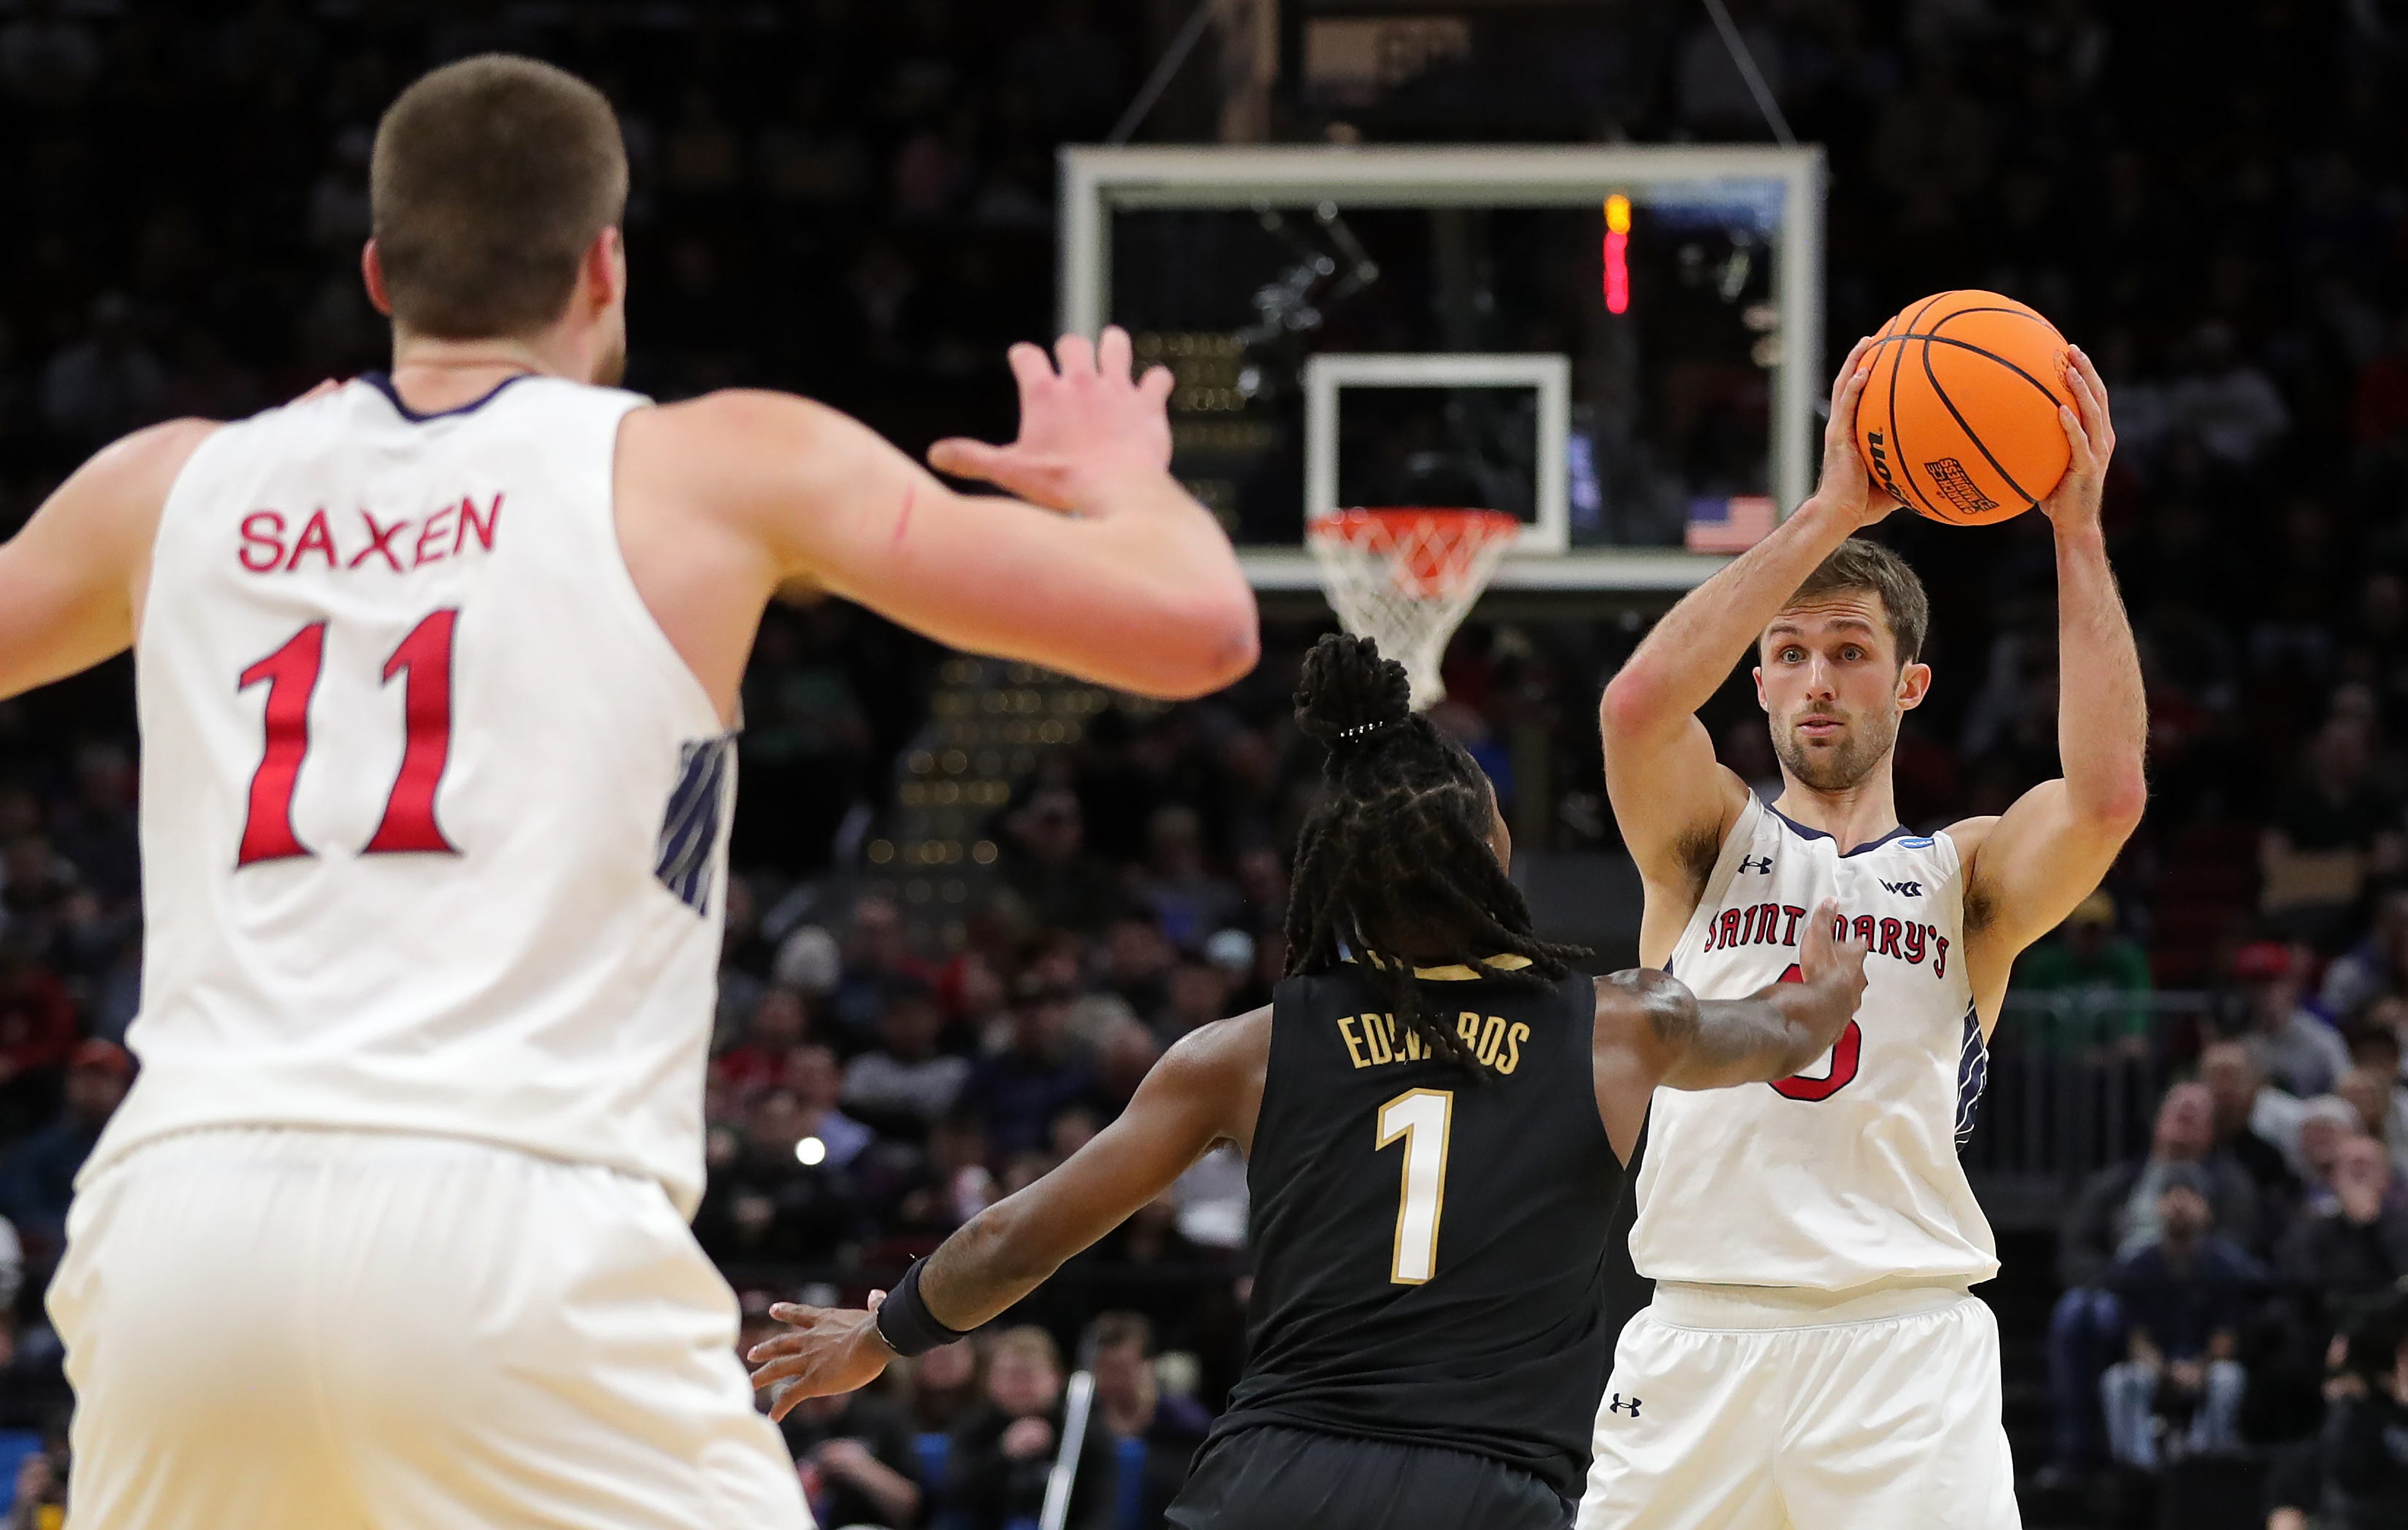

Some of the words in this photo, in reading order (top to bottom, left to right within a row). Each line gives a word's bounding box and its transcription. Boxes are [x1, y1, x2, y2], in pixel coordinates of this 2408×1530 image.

[239, 491, 504, 573] SAXEN
[235, 606, 465, 874] 11
[1878, 877, 1923, 897] WCC
[1704, 903, 1807, 953] SAINT
[1337, 1011, 1531, 1075] EDWRDS
[1375, 1087, 1454, 1285] 1
